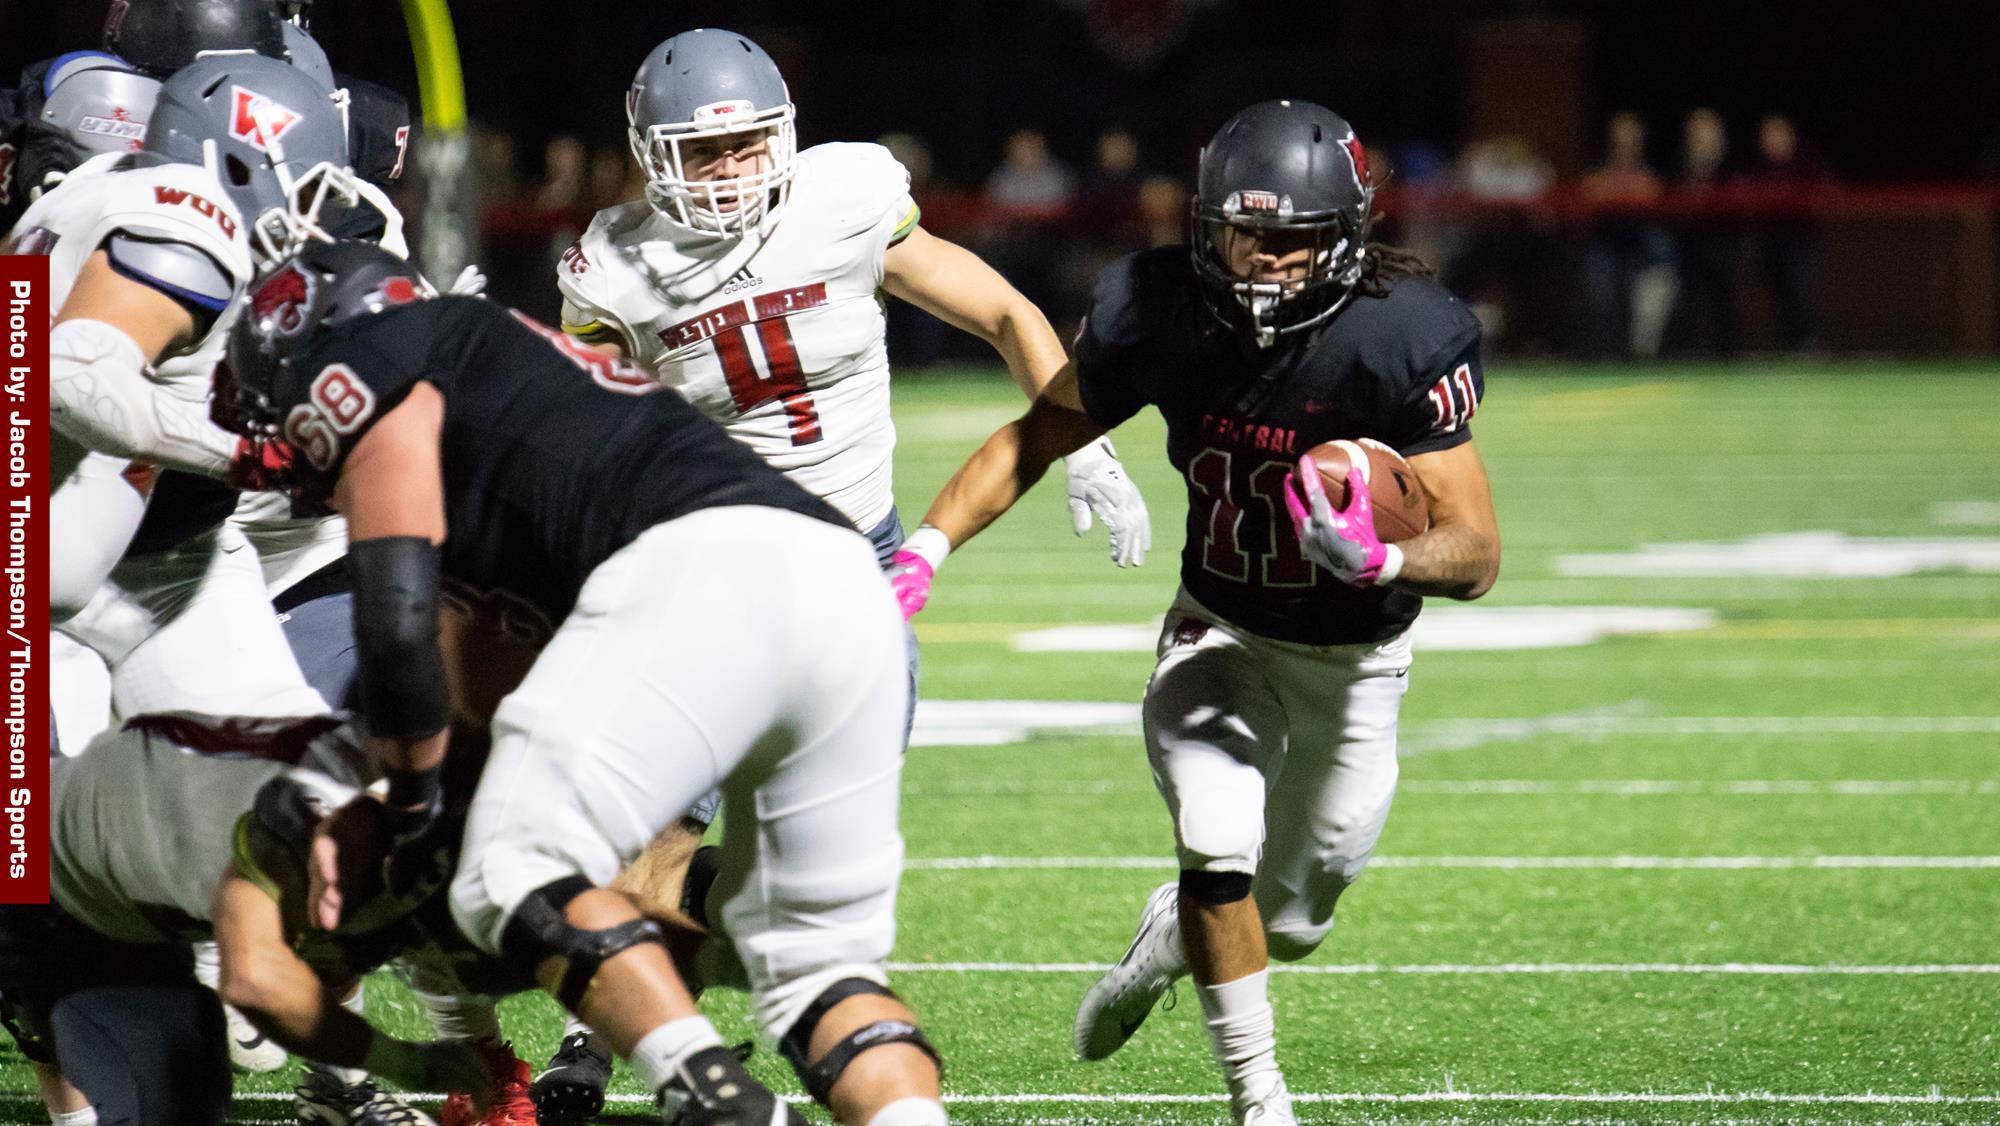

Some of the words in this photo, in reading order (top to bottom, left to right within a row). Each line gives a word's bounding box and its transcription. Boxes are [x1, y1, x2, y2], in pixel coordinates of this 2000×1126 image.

[154, 185, 236, 240] WOU
[723, 276, 763, 295] adidas
[284, 362, 376, 472] 68
[711, 304, 825, 448] 4
[1428, 362, 1477, 432] 11
[1189, 447, 1317, 587] 11
